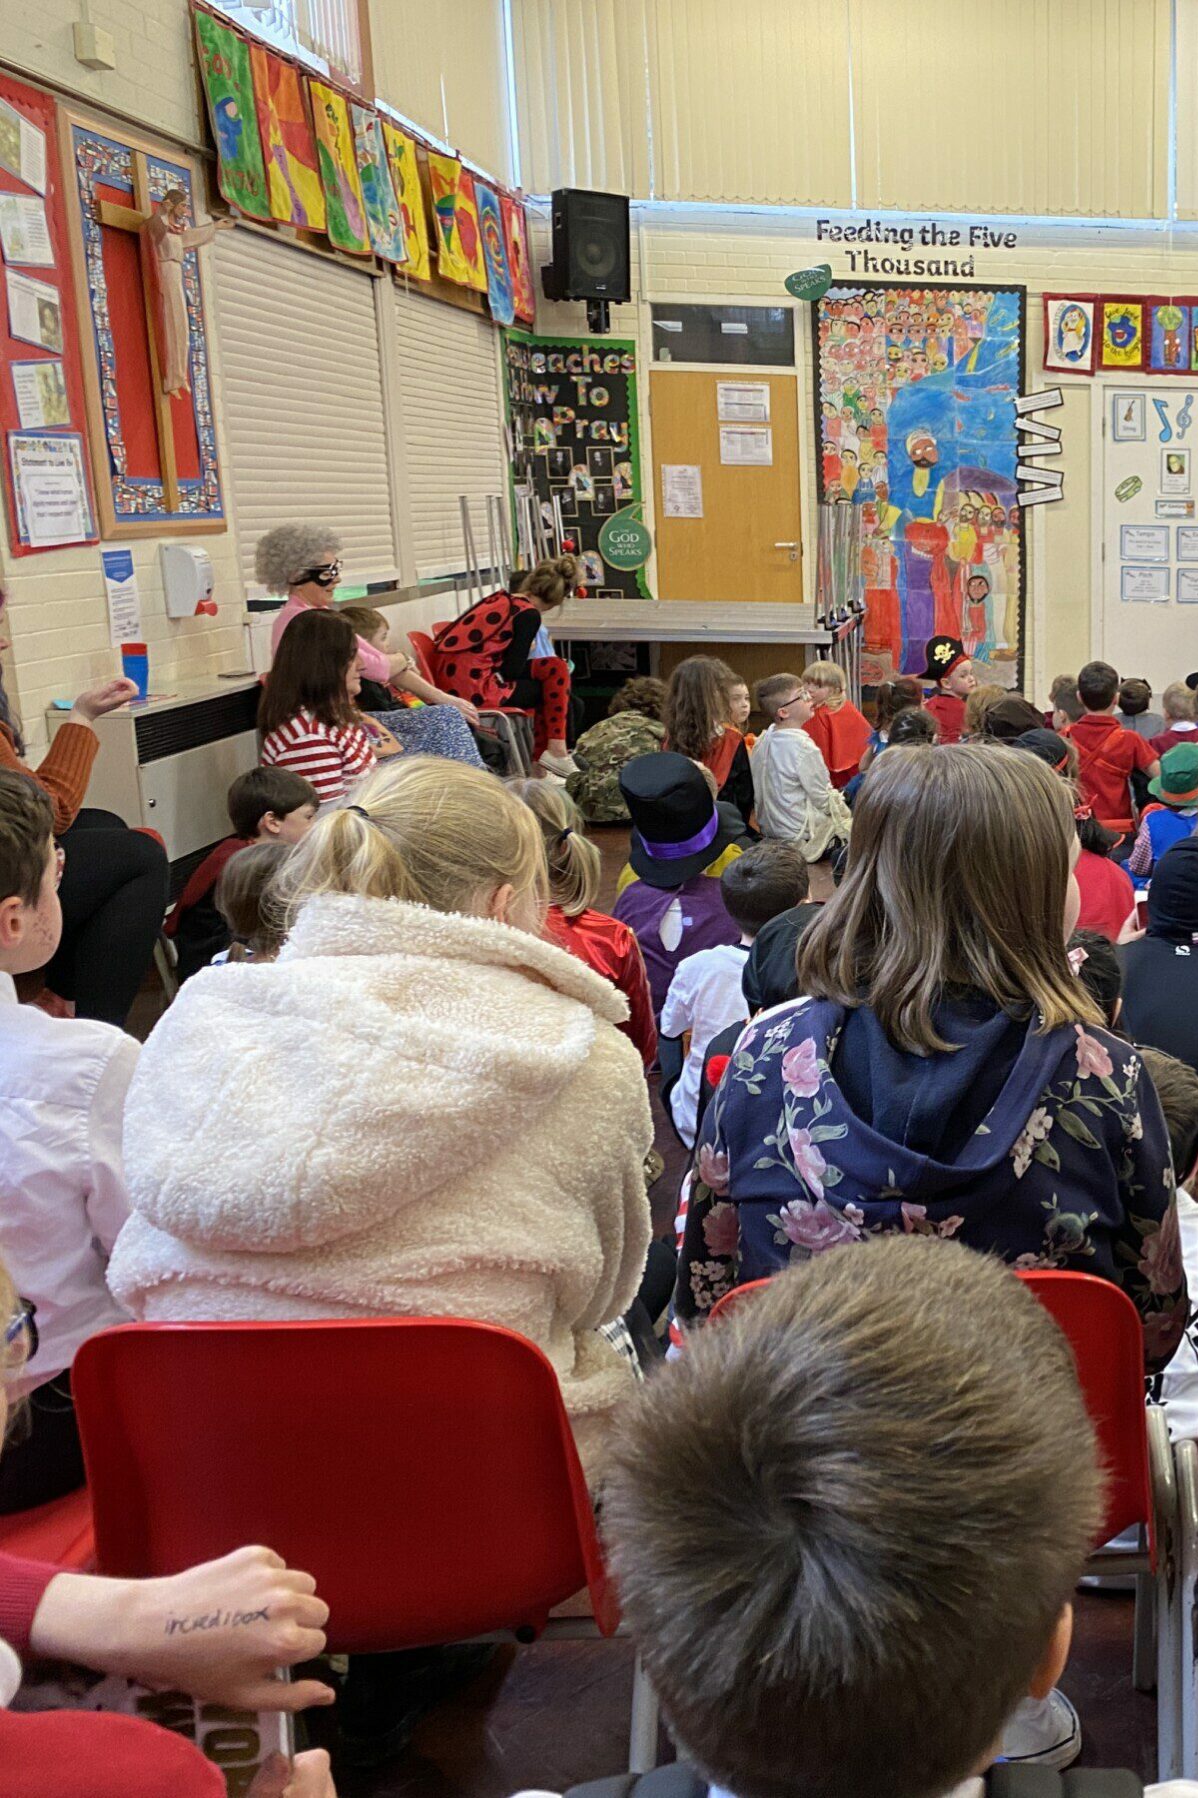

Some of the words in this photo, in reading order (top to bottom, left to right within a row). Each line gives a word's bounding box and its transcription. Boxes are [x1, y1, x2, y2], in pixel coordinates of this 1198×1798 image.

[816, 219, 914, 251] Feeding
[919, 223, 961, 246] the
[969, 226, 1018, 248] Five
[845, 249, 975, 277] Thousand
[569, 376, 610, 407] To
[552, 406, 629, 453] Pray
[609, 530, 640, 543] GOD
[608, 547, 642, 556] SPEAKS
